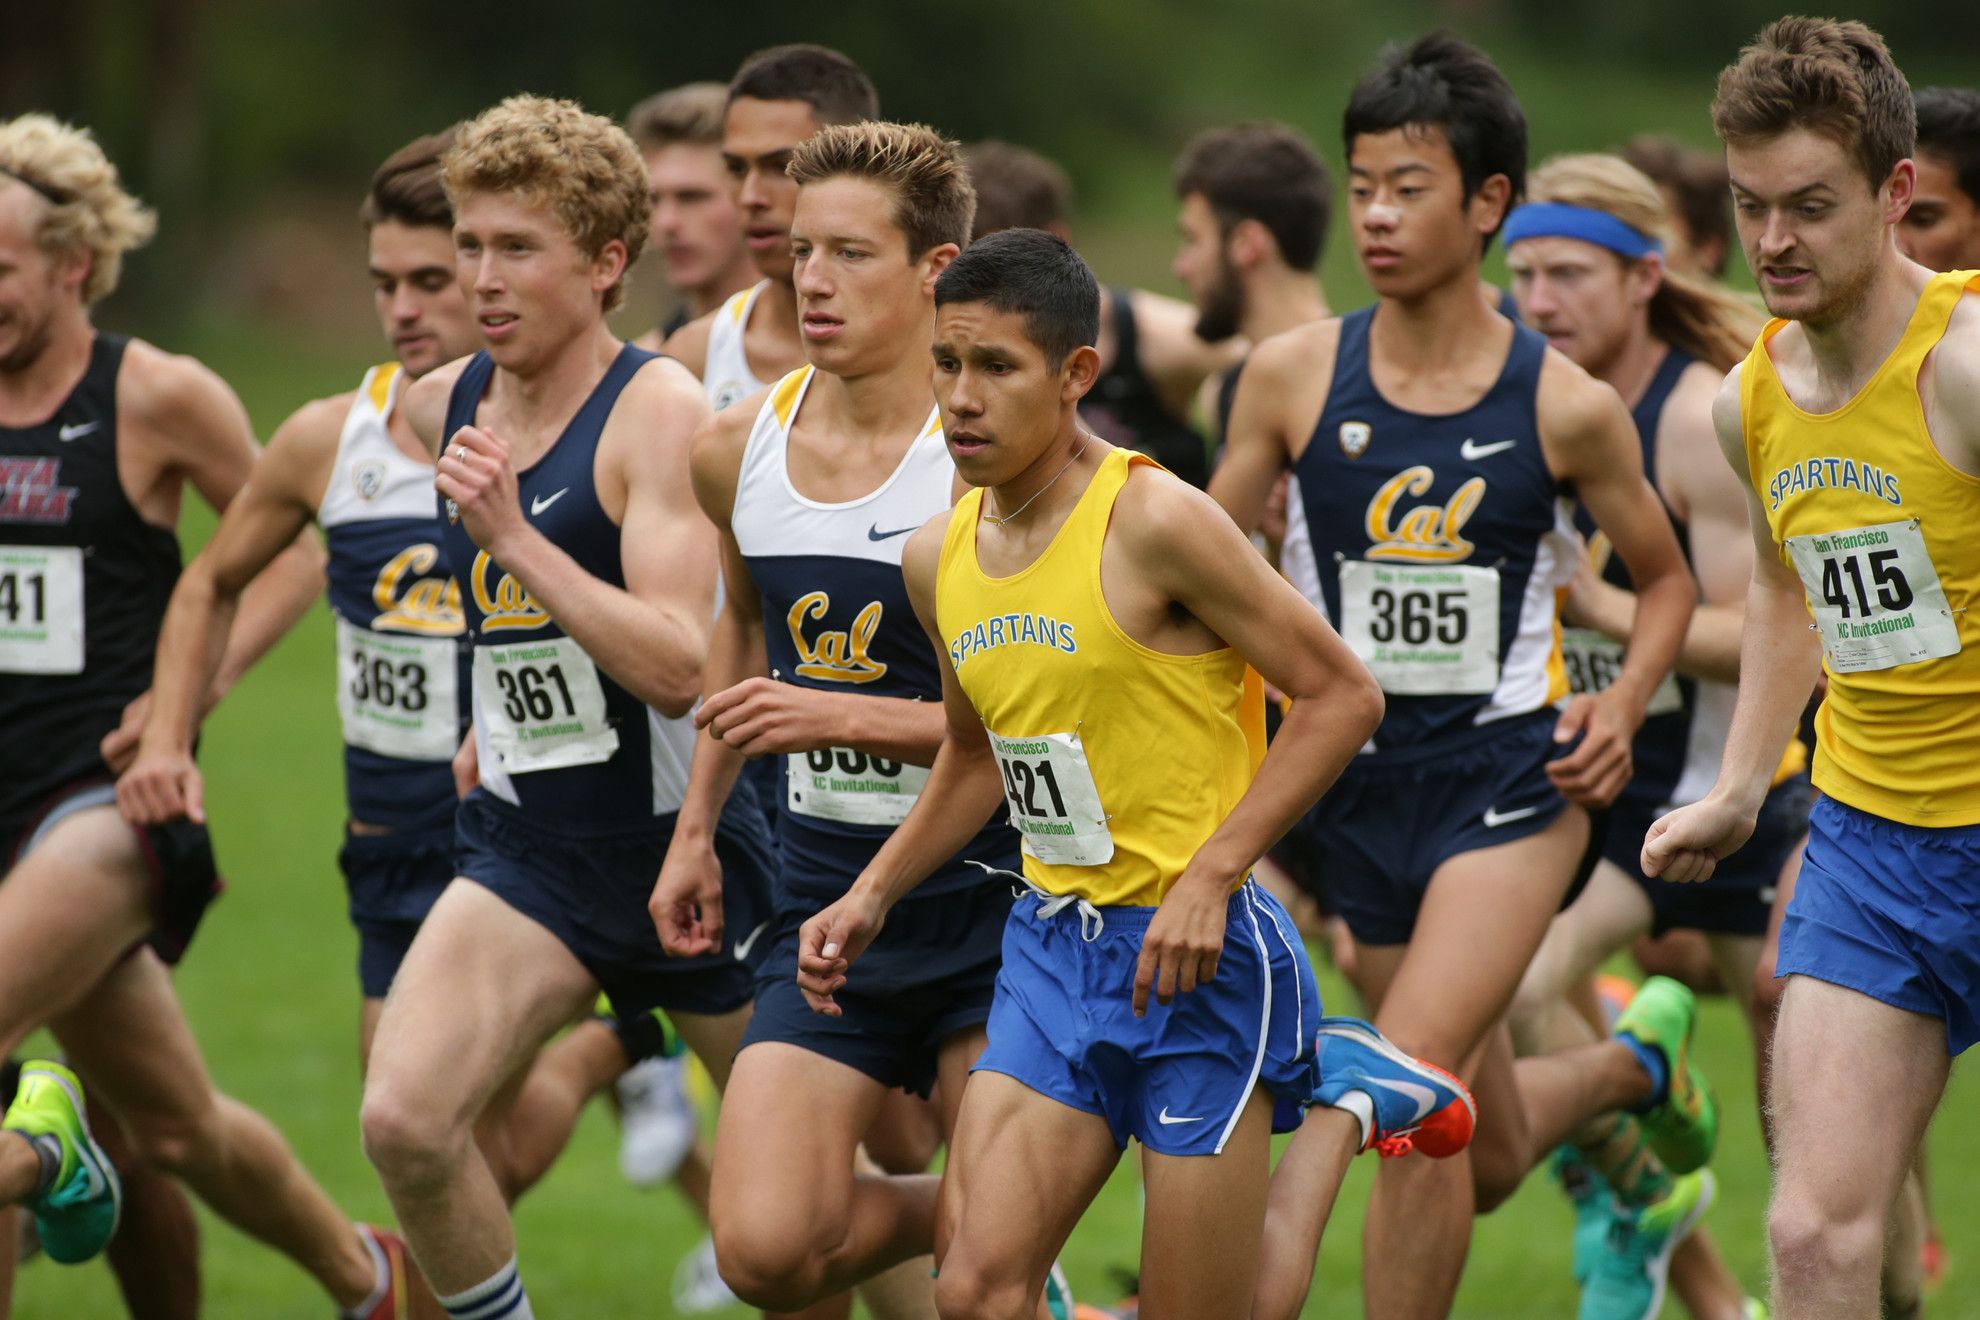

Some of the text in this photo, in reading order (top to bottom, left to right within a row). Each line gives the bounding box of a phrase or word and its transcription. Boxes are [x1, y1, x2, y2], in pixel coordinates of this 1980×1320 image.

[1770, 457, 1902, 512] SPARTANS
[1364, 465, 1486, 563] Cal
[1812, 531, 1889, 553] San Francisco
[1822, 549, 1914, 619] 415
[787, 590, 887, 684] Cal
[951, 613, 1077, 671] SPARTANS
[1371, 589, 1468, 645] 365
[1837, 613, 1915, 639] XC Invitational
[352, 651, 427, 711] 363
[496, 663, 576, 723] 361
[1002, 740, 1049, 755] Francisco
[812, 775, 900, 793] XC Invitational
[1002, 758, 1068, 818] 421
[1027, 820, 1075, 836] Invitational
